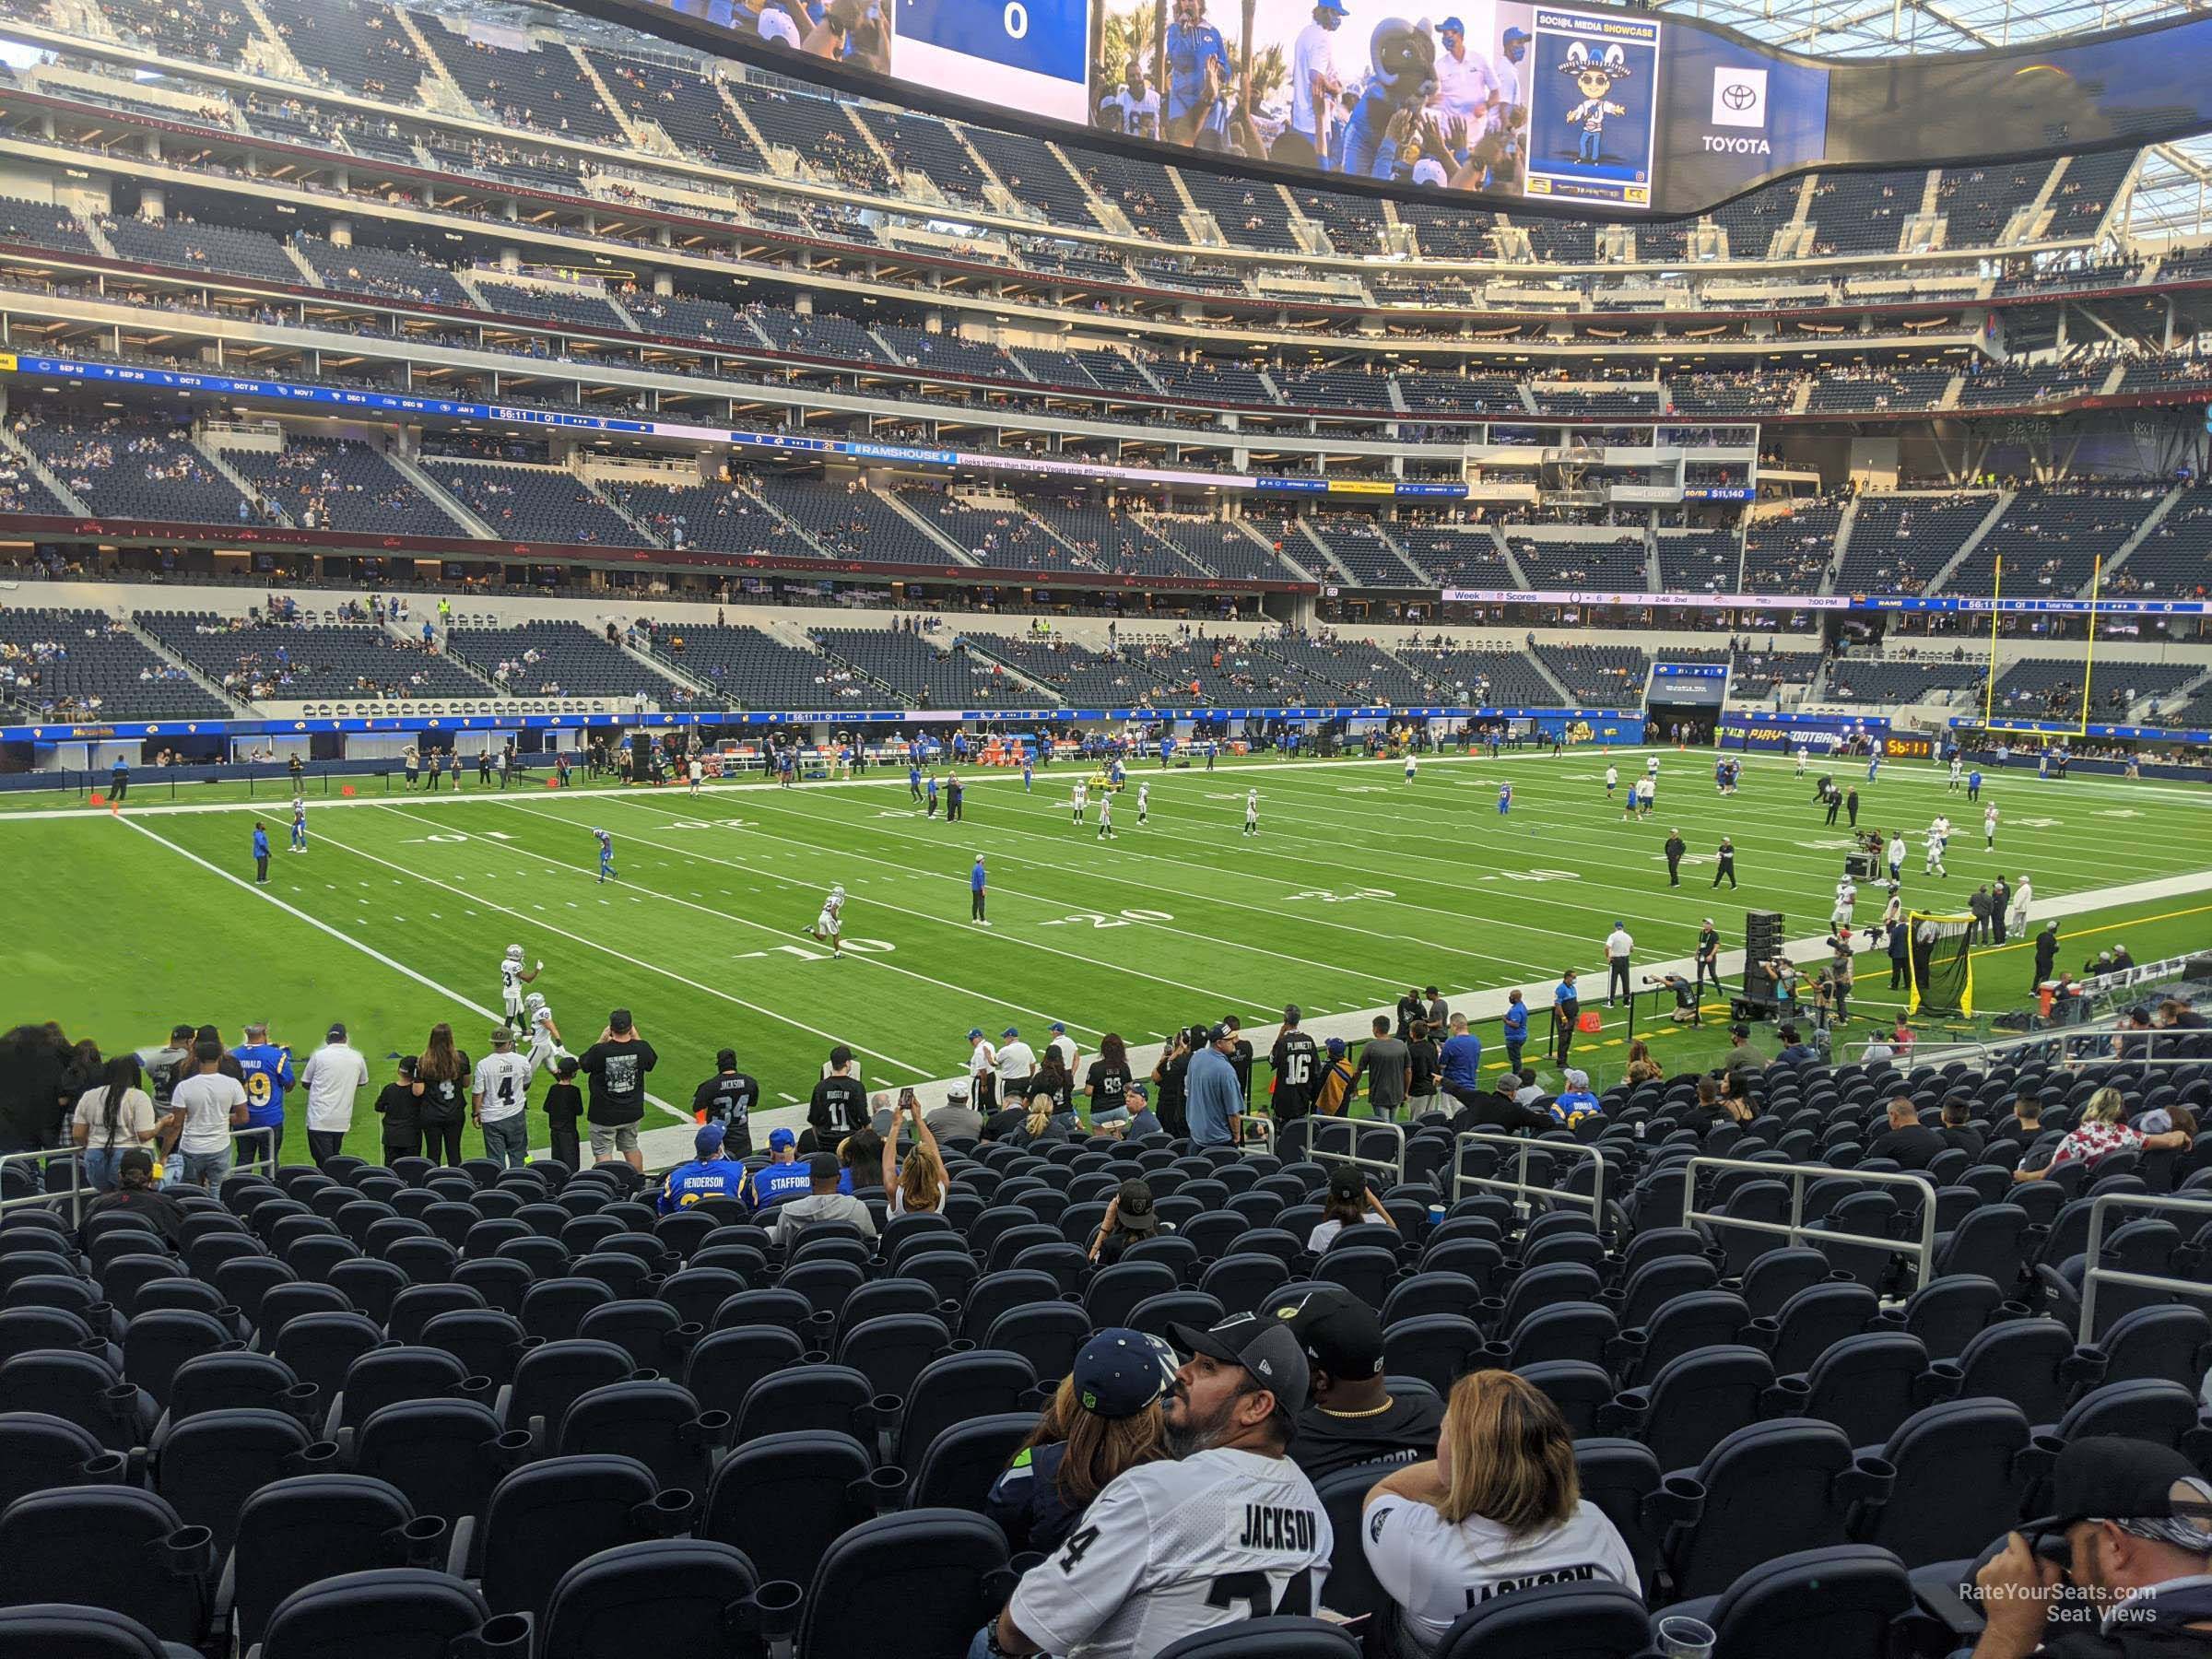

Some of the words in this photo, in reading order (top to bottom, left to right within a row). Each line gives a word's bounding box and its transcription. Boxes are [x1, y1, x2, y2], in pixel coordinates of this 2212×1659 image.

[1004, 1, 1028, 39] 0
[1574, 19, 1602, 31] MEDIA
[1604, 24, 1653, 37] SHOWCASE
[1702, 135, 1771, 155] TOYOTA
[59, 364, 75, 372] SEP
[119, 371, 134, 379] SEP
[180, 377, 194, 385] OCT
[234, 382, 248, 392] OCT
[294, 389, 308, 397] NOV
[347, 394, 359, 403] DEC
[402, 400, 415, 408] DEC
[456, 406, 469, 414] JAN
[500, 409, 526, 420] 56:11
[756, 435, 762, 443] 0
[854, 444, 939, 461] #RAMSHOUSE
[960, 457, 981, 466] Looks
[982, 459, 1002, 467] better
[1005, 461, 1018, 469] than
[1033, 464, 1044, 472] Las
[1046, 465, 1066, 474] Vegas
[1068, 467, 1082, 476] strip
[1084, 468, 1126, 477] #RamsHouse
[1712, 489, 1745, 500] $11,140
[1455, 592, 1479, 600] Week
[1506, 593, 1537, 601] Scores
[1969, 600, 1995, 608] 56:11
[2015, 601, 2026, 609] Q1
[1748, 729, 1783, 741] PLAY
[1888, 740, 1928, 753] 56:11
[1065, 909, 1174, 930] 20
[767, 937, 897, 962] 10
[500, 1065, 513, 1074] CARR
[1286, 1053, 1312, 1085] 16
[720, 1078, 746, 1090] JACKSON
[498, 1077, 515, 1106] 4
[712, 1093, 750, 1126] 34
[830, 1102, 851, 1132] 11
[684, 1176, 724, 1189] HENDERSON
[771, 1176, 810, 1191] STAFFORD
[1240, 1503, 1316, 1553] JACKSON
